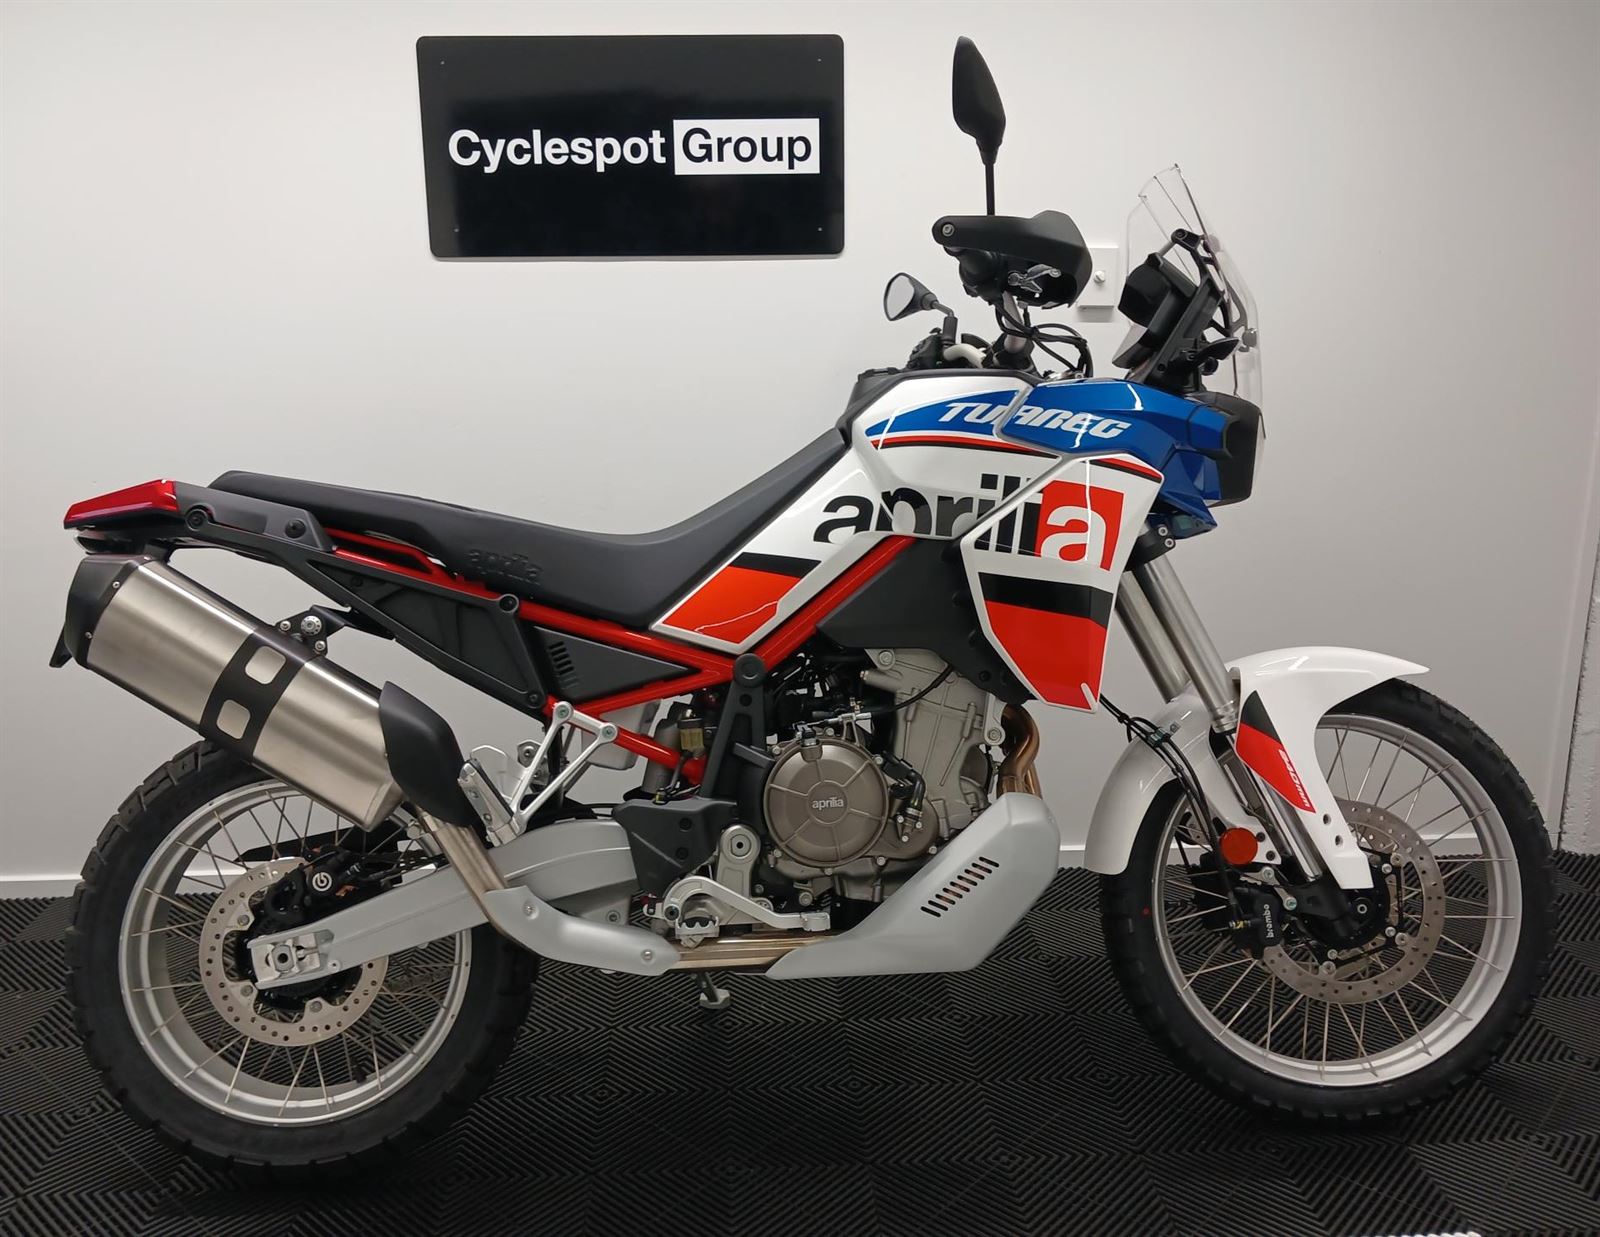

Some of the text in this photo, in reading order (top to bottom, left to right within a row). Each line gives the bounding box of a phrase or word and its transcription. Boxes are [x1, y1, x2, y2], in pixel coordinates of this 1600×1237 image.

[448, 127, 812, 173] Cyclespot Group
[938, 402, 1132, 439] TUAREG
[813, 473, 1122, 570] aprilia
[812, 797, 844, 810] aprilia
[1263, 903, 1275, 939] brembo
